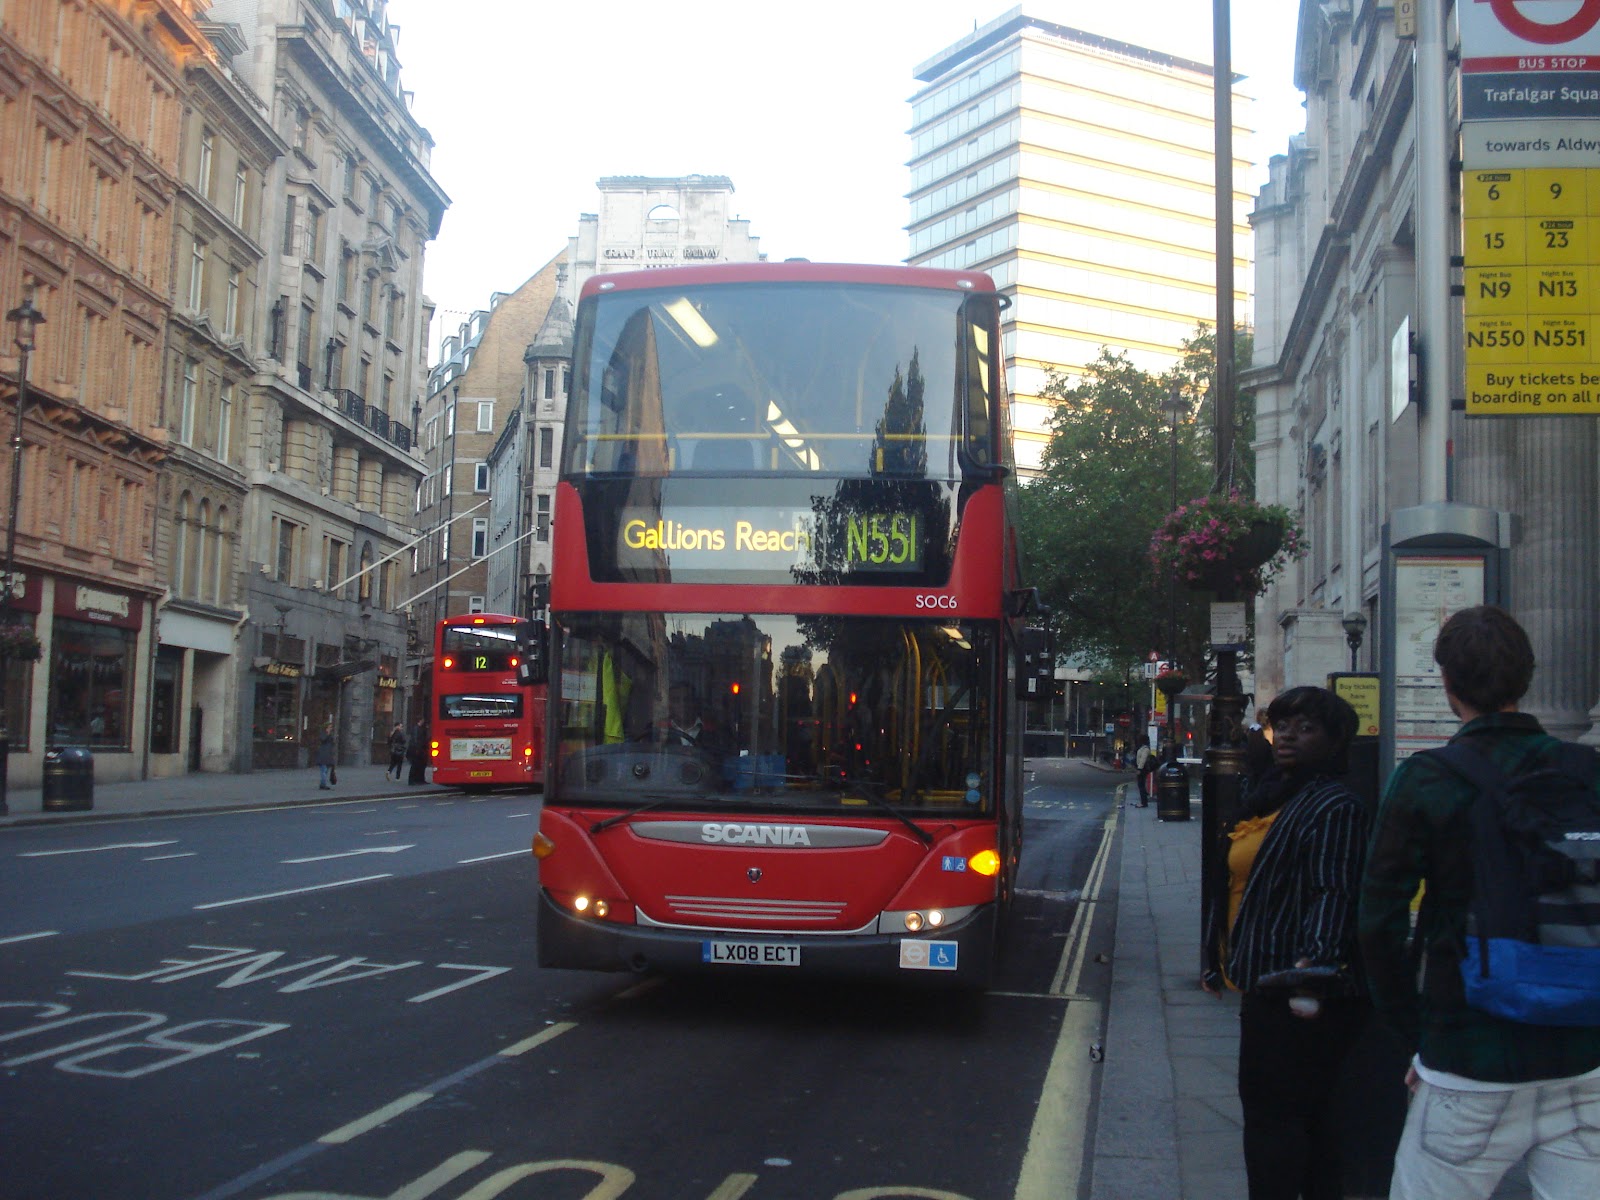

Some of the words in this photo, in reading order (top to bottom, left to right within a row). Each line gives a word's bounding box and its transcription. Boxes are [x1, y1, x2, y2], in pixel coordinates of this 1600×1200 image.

[1518, 58, 1545, 69] BUS
[1551, 58, 1587, 69] STOP
[1484, 87, 1556, 104] Trafalgar
[1561, 87, 1600, 103] Squa
[1486, 138, 1550, 152] towards
[1487, 184, 1500, 201] 6
[1549, 183, 1562, 200] 9
[1484, 232, 1505, 249] 15
[1545, 231, 1569, 248] 23
[603, 249, 636, 259] GRAND
[682, 248, 720, 260] RAILWAY
[1480, 281, 1511, 298] N9
[1538, 280, 1578, 297] N13
[1467, 330, 1525, 347] N550
[1533, 329, 1585, 346] N551
[1486, 373, 1515, 388] Buy
[1520, 372, 1575, 385] tickets
[1580, 372, 1600, 385] be
[1472, 391, 1541, 406] boarding
[1547, 394, 1566, 403] on
[1572, 390, 1591, 403] all
[624, 519, 726, 551] Gallions
[735, 520, 811, 552] Reach
[847, 512, 917, 565] N551
[915, 594, 958, 610] SOC6
[475, 656, 487, 669] 12
[701, 823, 811, 846] SCANIA
[713, 944, 758, 961] LX08
[763, 945, 798, 962] ECT
[65, 944, 513, 1003] LANE
